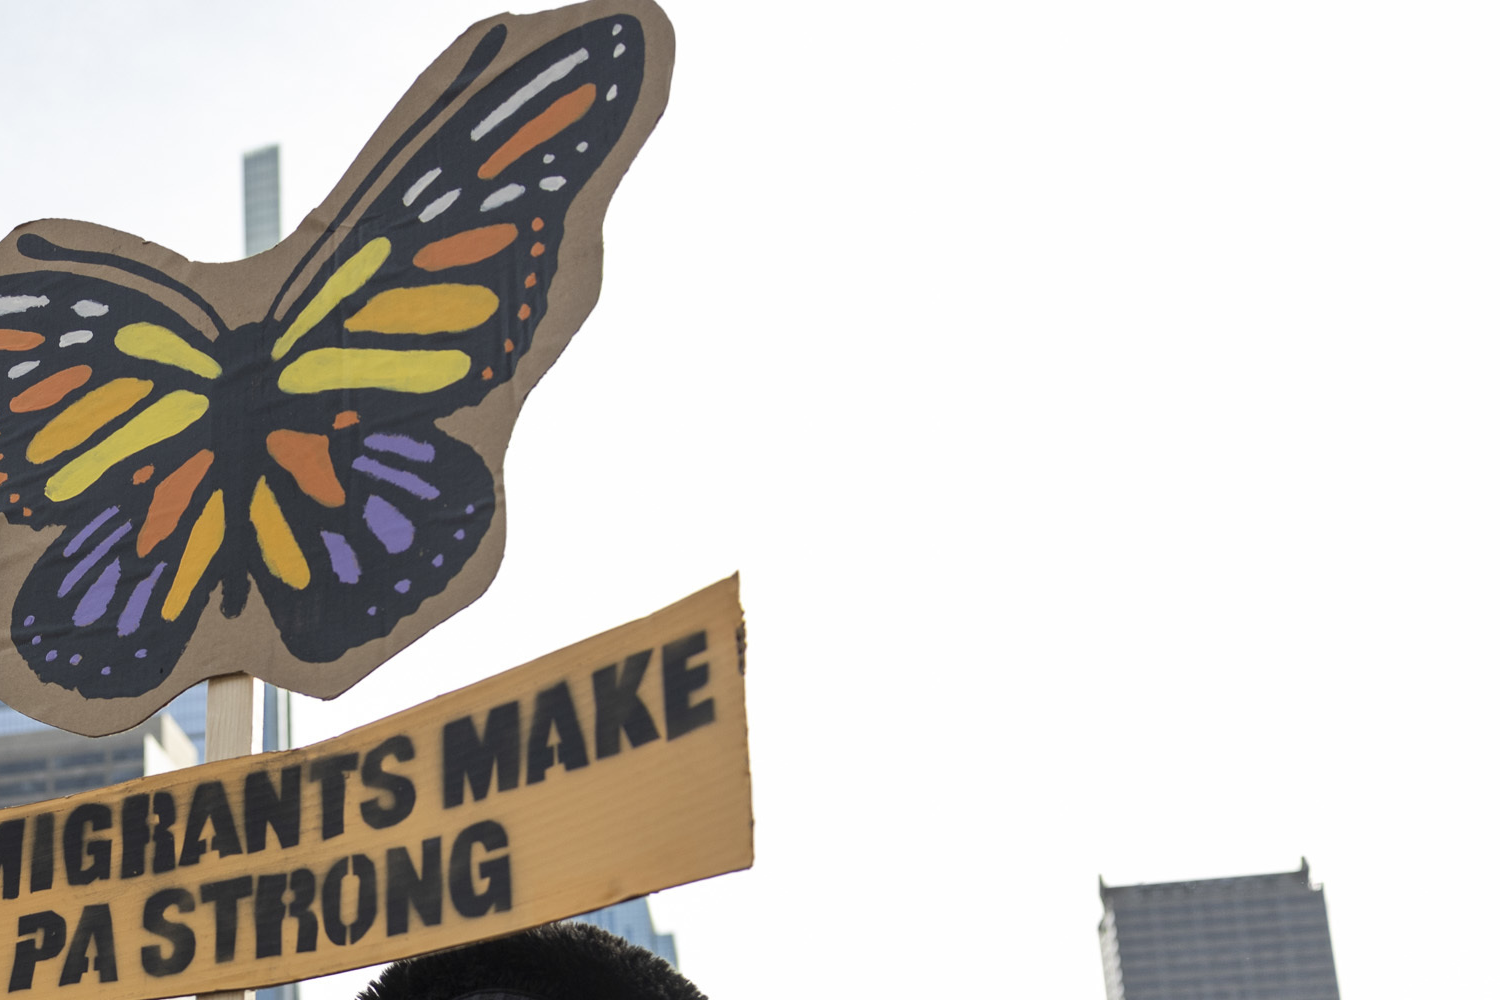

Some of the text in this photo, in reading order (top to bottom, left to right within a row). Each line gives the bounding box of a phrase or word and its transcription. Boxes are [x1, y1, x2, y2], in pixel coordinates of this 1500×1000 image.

[442, 630, 716, 810] MAKE
[8, 819, 513, 993] PA STRONG
